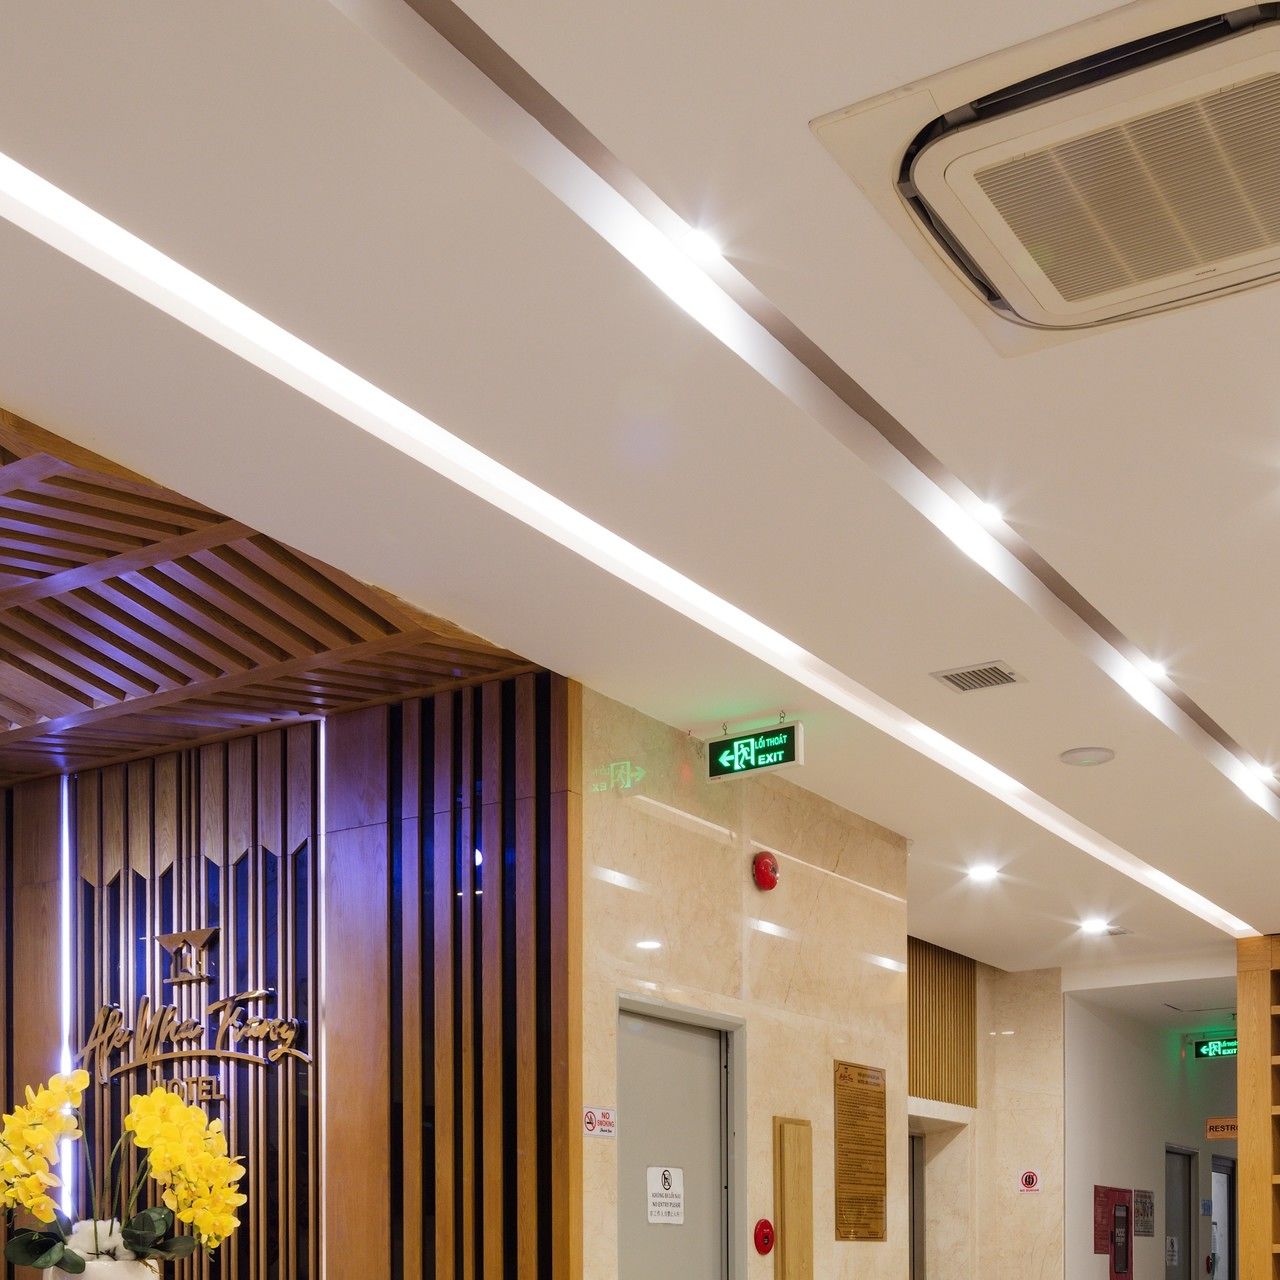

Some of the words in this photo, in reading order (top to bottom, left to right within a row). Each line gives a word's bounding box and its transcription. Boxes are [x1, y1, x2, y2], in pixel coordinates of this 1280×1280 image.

[754, 735, 765, 750] LỐI
[766, 733, 788, 748] THOÁT
[758, 751, 785, 765] EXIT
[206, 990, 312, 1063] Trang
